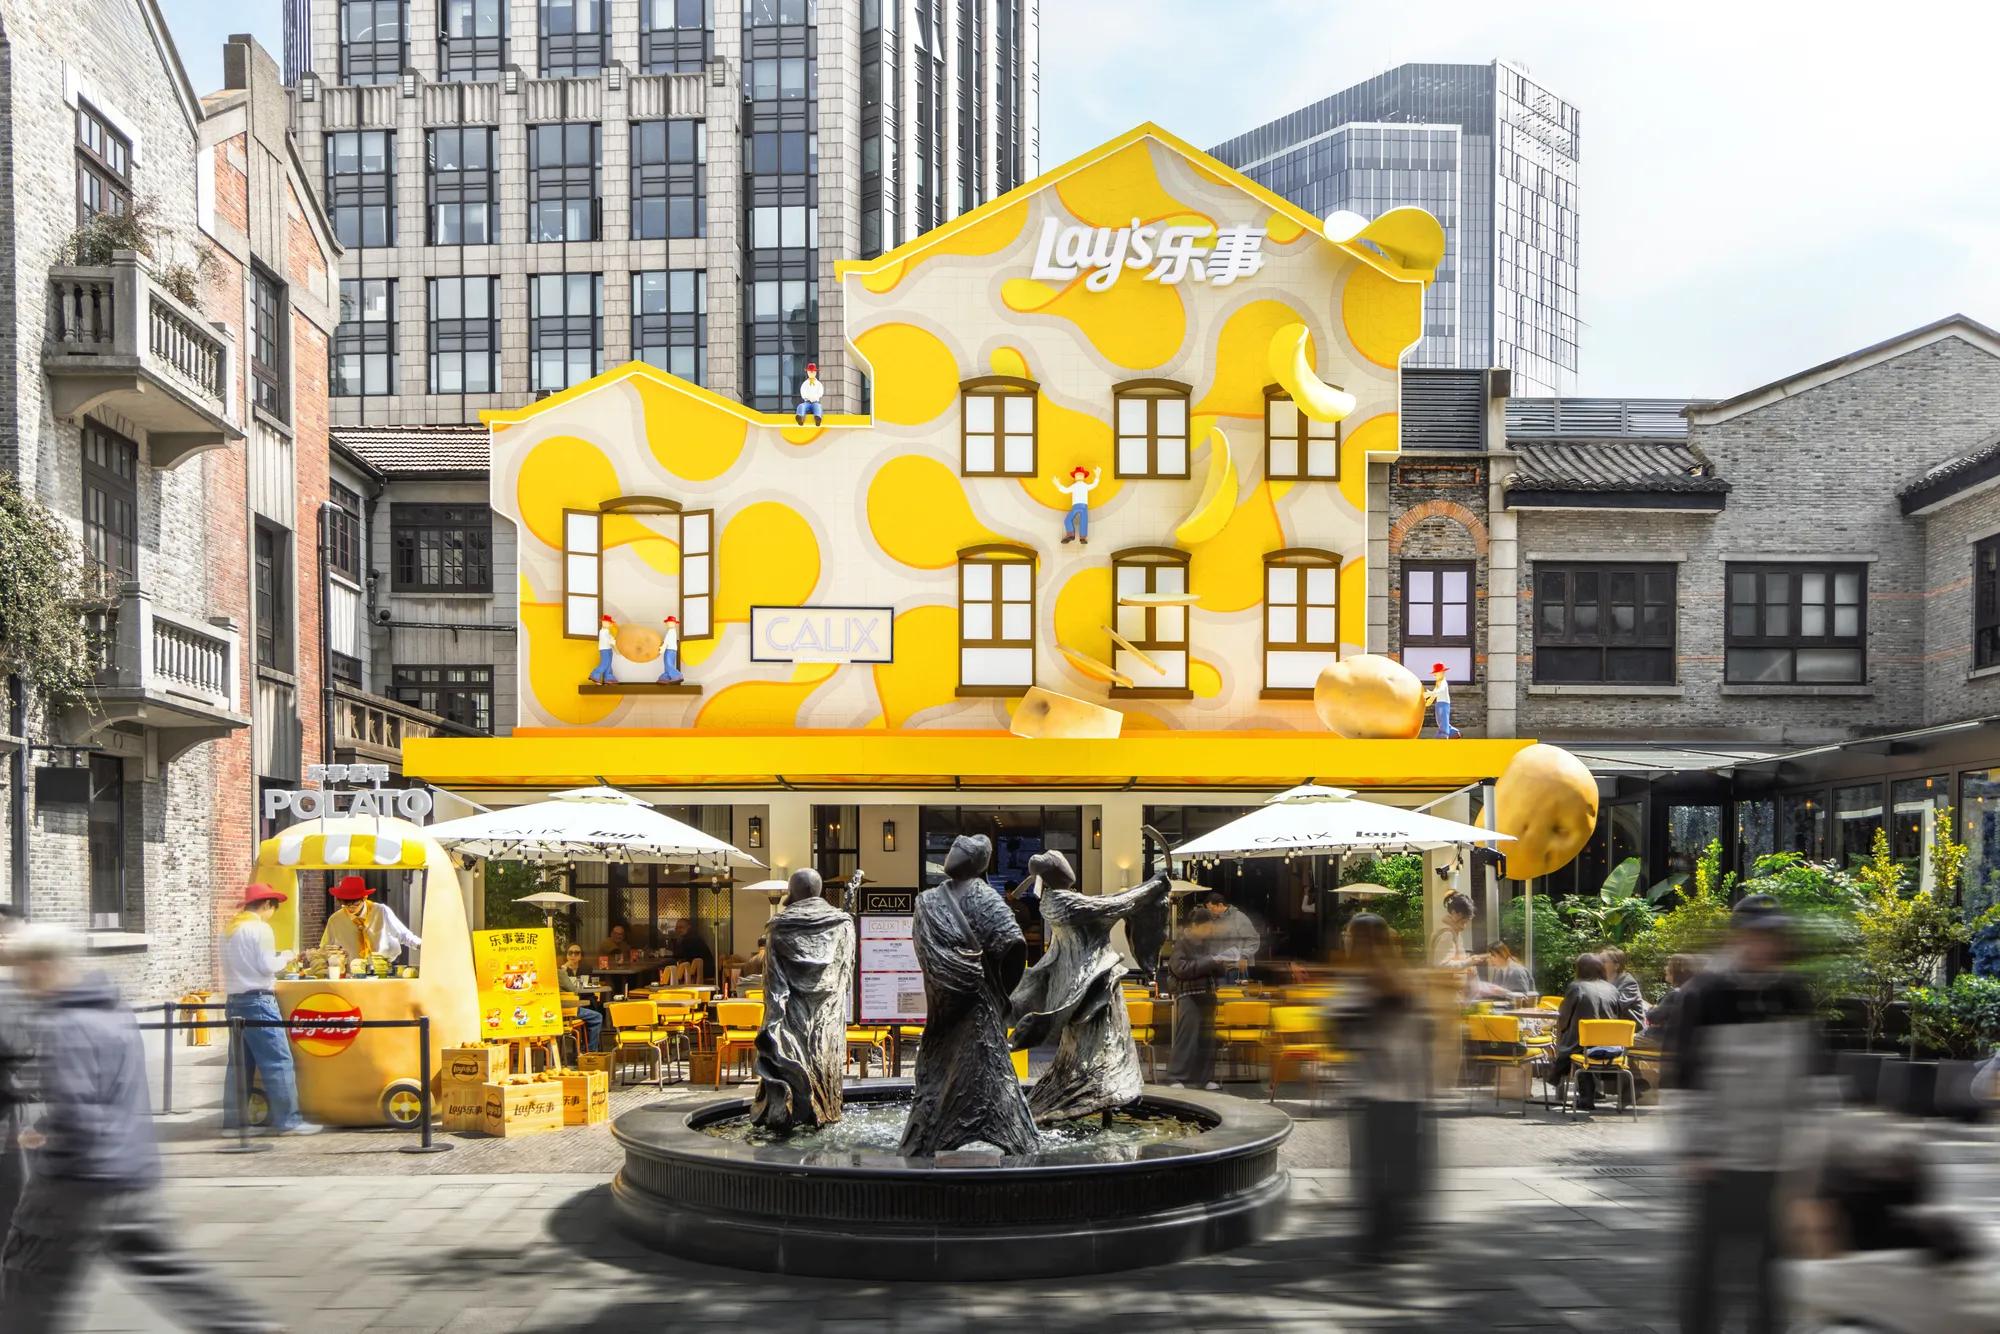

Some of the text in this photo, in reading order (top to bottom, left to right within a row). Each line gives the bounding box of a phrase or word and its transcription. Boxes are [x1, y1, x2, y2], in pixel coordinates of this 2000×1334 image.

[765, 616, 880, 653] CALIX
[264, 788, 432, 820] POLATO
[1254, 831, 1332, 844] CALIX
[871, 896, 906, 908] CALIX
